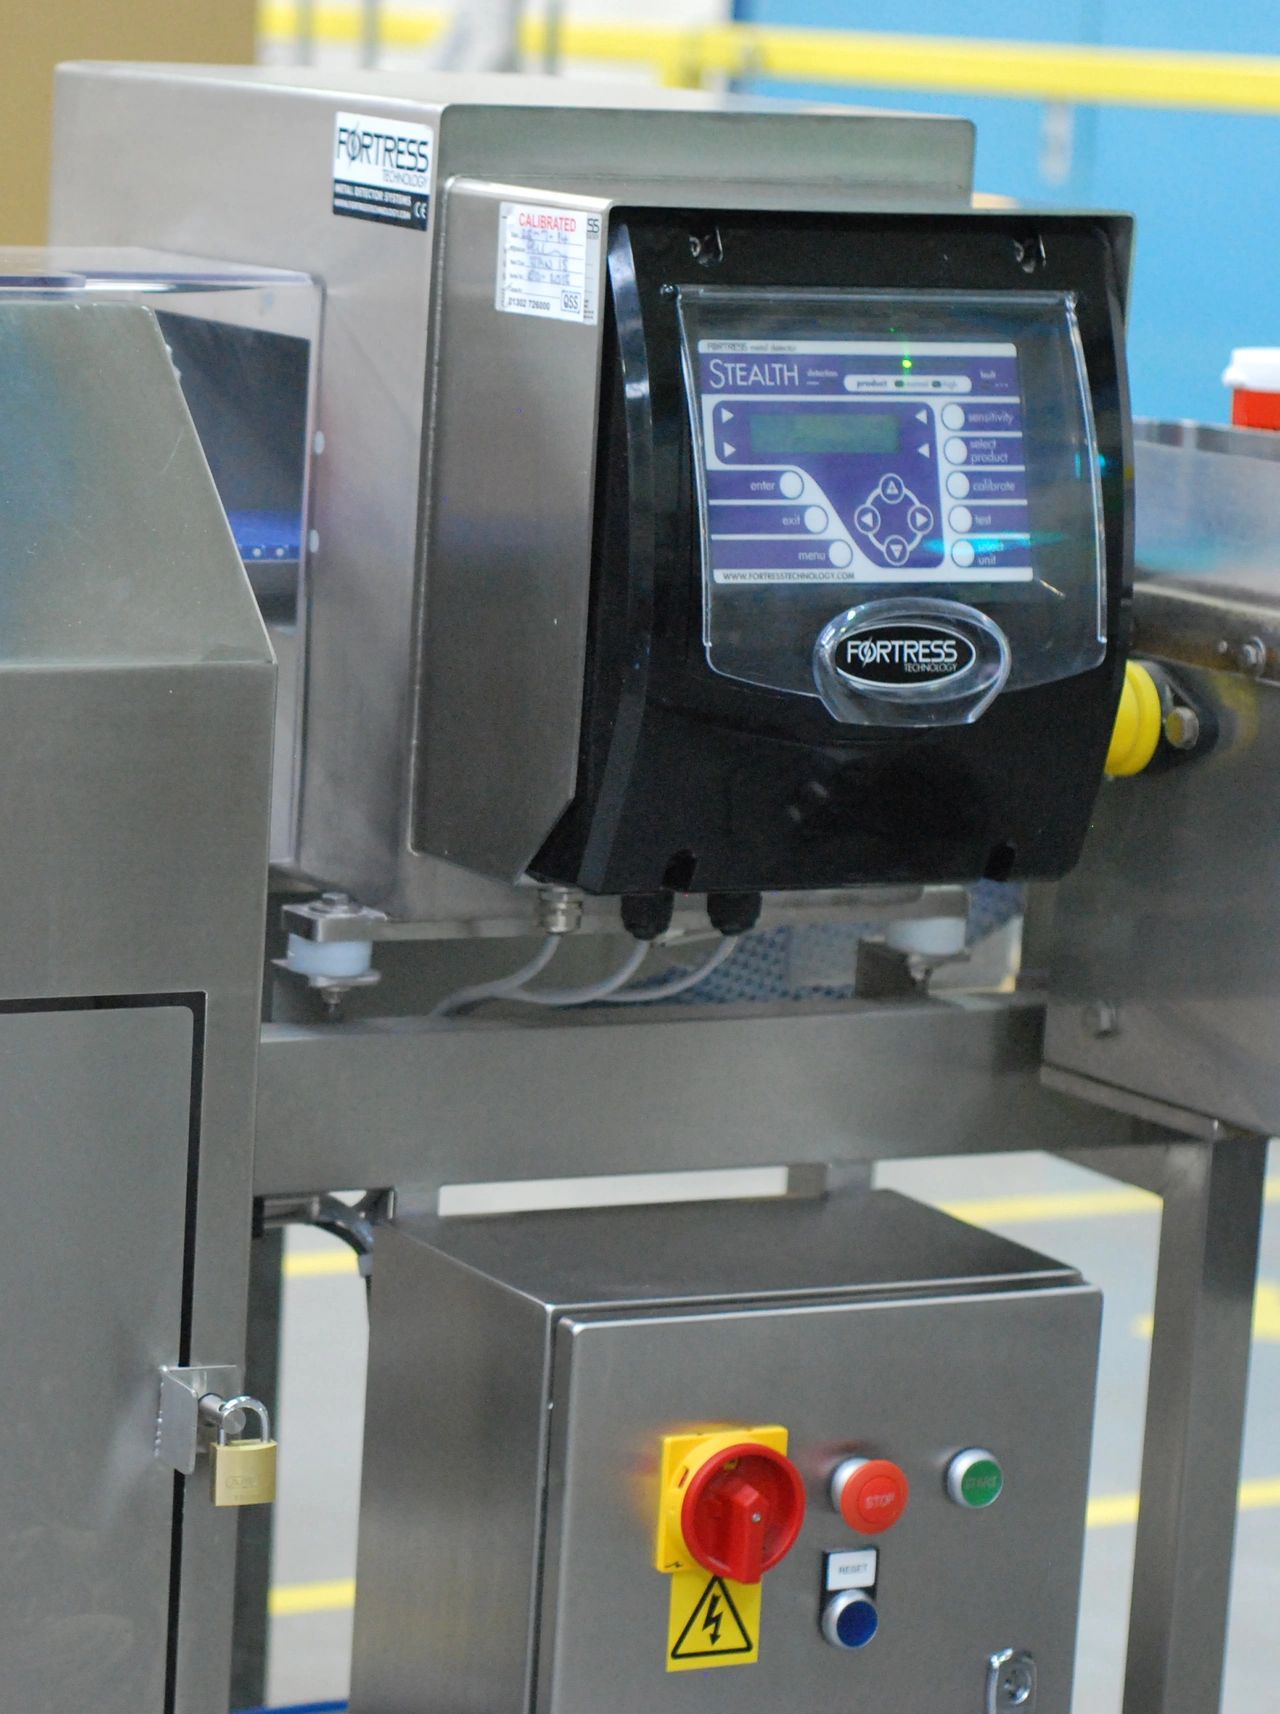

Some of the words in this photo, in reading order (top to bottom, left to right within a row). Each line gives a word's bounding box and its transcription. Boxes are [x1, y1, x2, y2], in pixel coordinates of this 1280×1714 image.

[336, 126, 430, 173] FORTRESS
[383, 169, 427, 188] TECHNOLOGY
[519, 213, 577, 233] CALIBRATED
[709, 358, 800, 389] STEALTH
[856, 377, 887, 388] product
[968, 412, 1014, 425] sensitivity
[971, 439, 996, 449] select
[971, 451, 1009, 464] product
[750, 480, 776, 491] enter
[972, 478, 1016, 492] calibrate
[782, 514, 800, 526] exit
[974, 514, 992, 526] test
[798, 551, 826, 561] menu
[978, 554, 997, 566] unit
[722, 570, 855, 581] WWW.FORTRESSTECHNOLOGY.COM
[846, 638, 958, 665] FORTRESS
[904, 662, 957, 673] TECHNOLOGY
[864, 1493, 896, 1510] STOP
[838, 1563, 868, 1575] RESET
